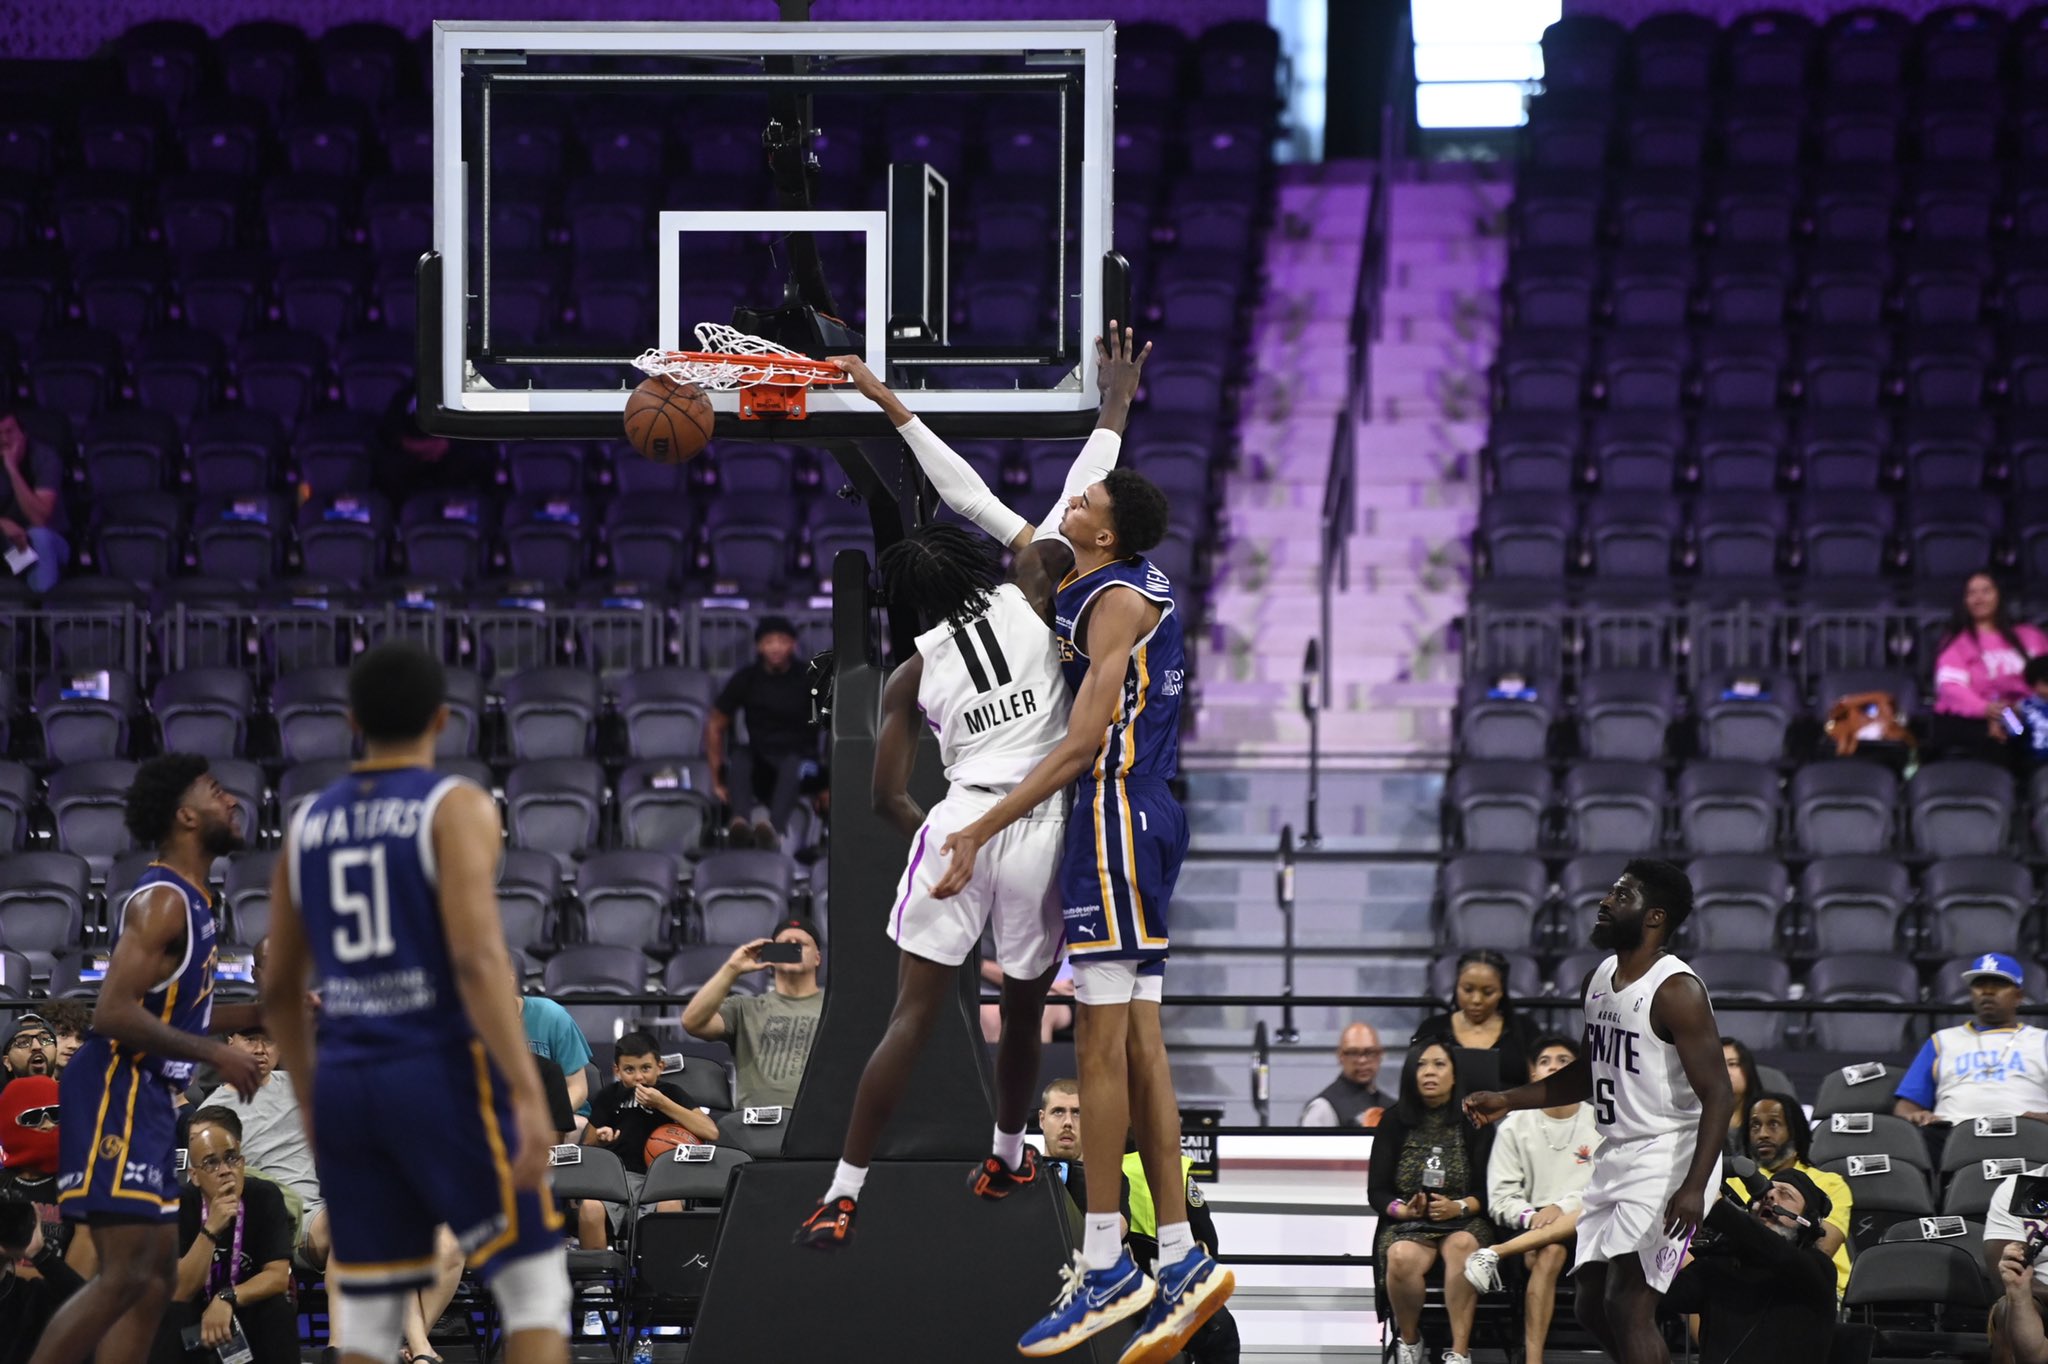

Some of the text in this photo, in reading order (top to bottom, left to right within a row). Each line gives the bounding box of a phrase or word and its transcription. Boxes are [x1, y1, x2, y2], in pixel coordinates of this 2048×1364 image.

[952, 617, 1013, 695] 11
[963, 689, 1037, 735] MILLER
[301, 799, 422, 852] WATERS
[1139, 811, 1148, 832] 1
[328, 842, 396, 963] 51
[1955, 1050, 2026, 1076] UCLA
[1596, 1078, 1616, 1126] 5
[2023, 1220, 2048, 1247] 2
